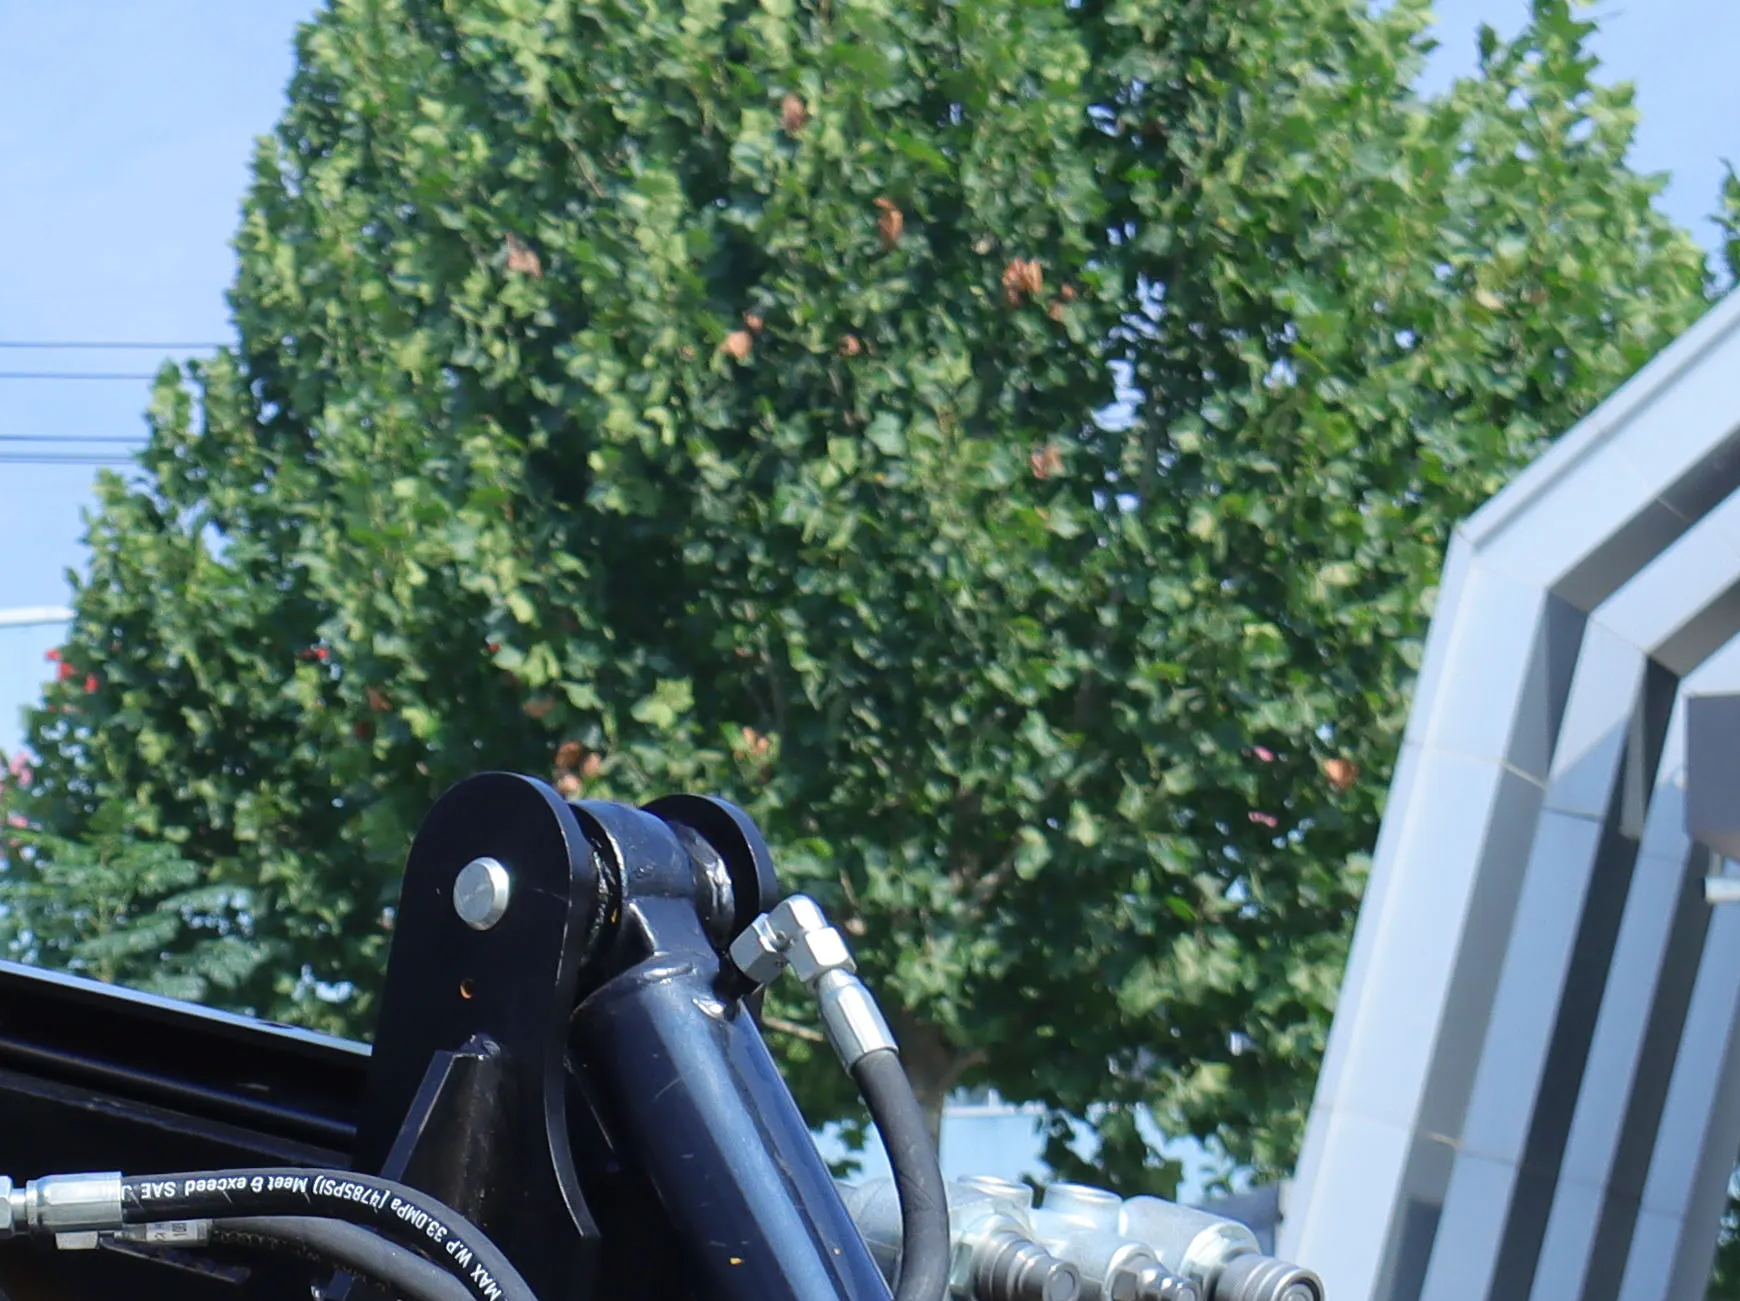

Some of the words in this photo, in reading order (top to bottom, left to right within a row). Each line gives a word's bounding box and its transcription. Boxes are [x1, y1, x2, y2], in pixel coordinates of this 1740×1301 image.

[140, 1181, 176, 1199] SAE
[184, 1178, 247, 1196] exceed
[251, 1177, 264, 1193] &
[268, 1176, 309, 1194] Meet
[390, 1198, 448, 1243] 33.0MPa
[445, 1240, 473, 1268] W.P
